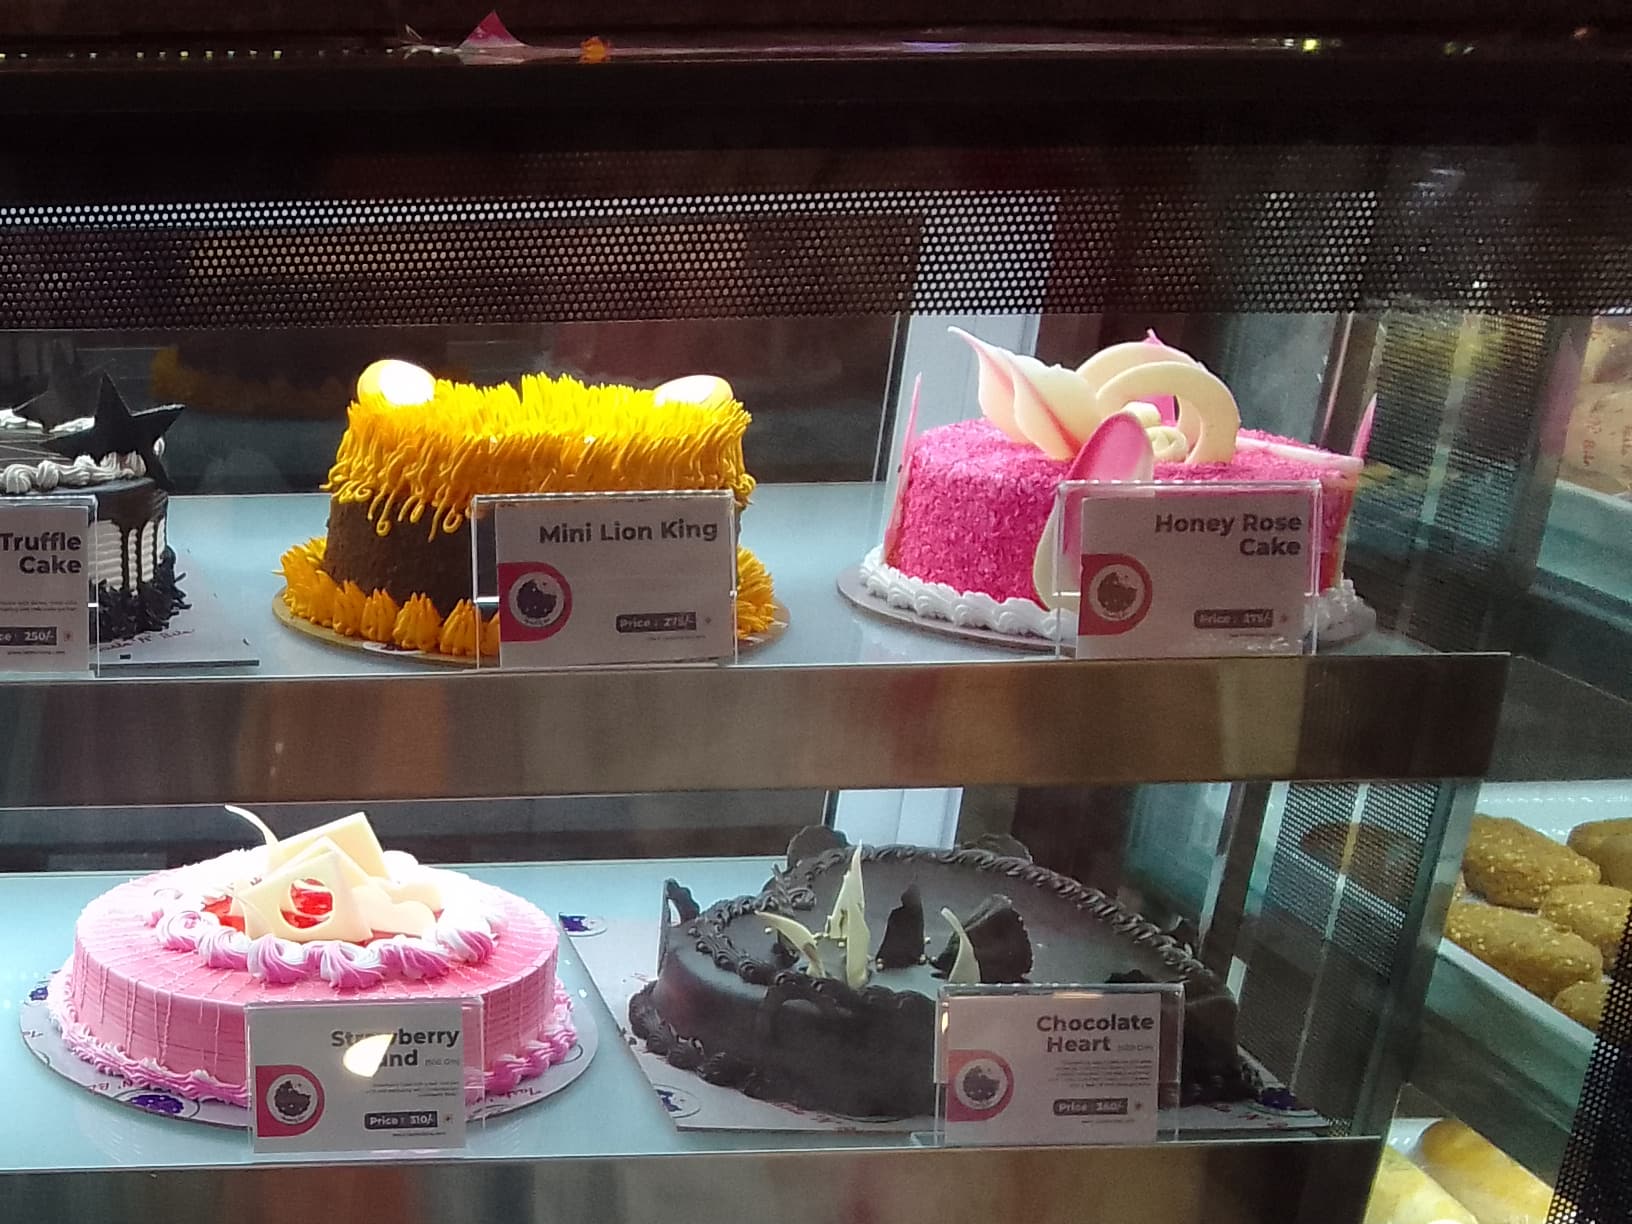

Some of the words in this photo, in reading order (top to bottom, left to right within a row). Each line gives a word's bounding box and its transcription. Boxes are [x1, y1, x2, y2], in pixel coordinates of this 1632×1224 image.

[539, 522, 592, 544] Mini
[600, 520, 653, 542] Lion
[660, 518, 718, 542] King
[1155, 514, 1234, 537] Honey
[1242, 513, 1302, 532] Rose
[1239, 538, 1302, 557] Cake
[18, 555, 82, 575] Cake
[1037, 1014, 1155, 1032] Chocolate
[1047, 1036, 1112, 1053] Heart
[369, 1116, 398, 1126] Price
